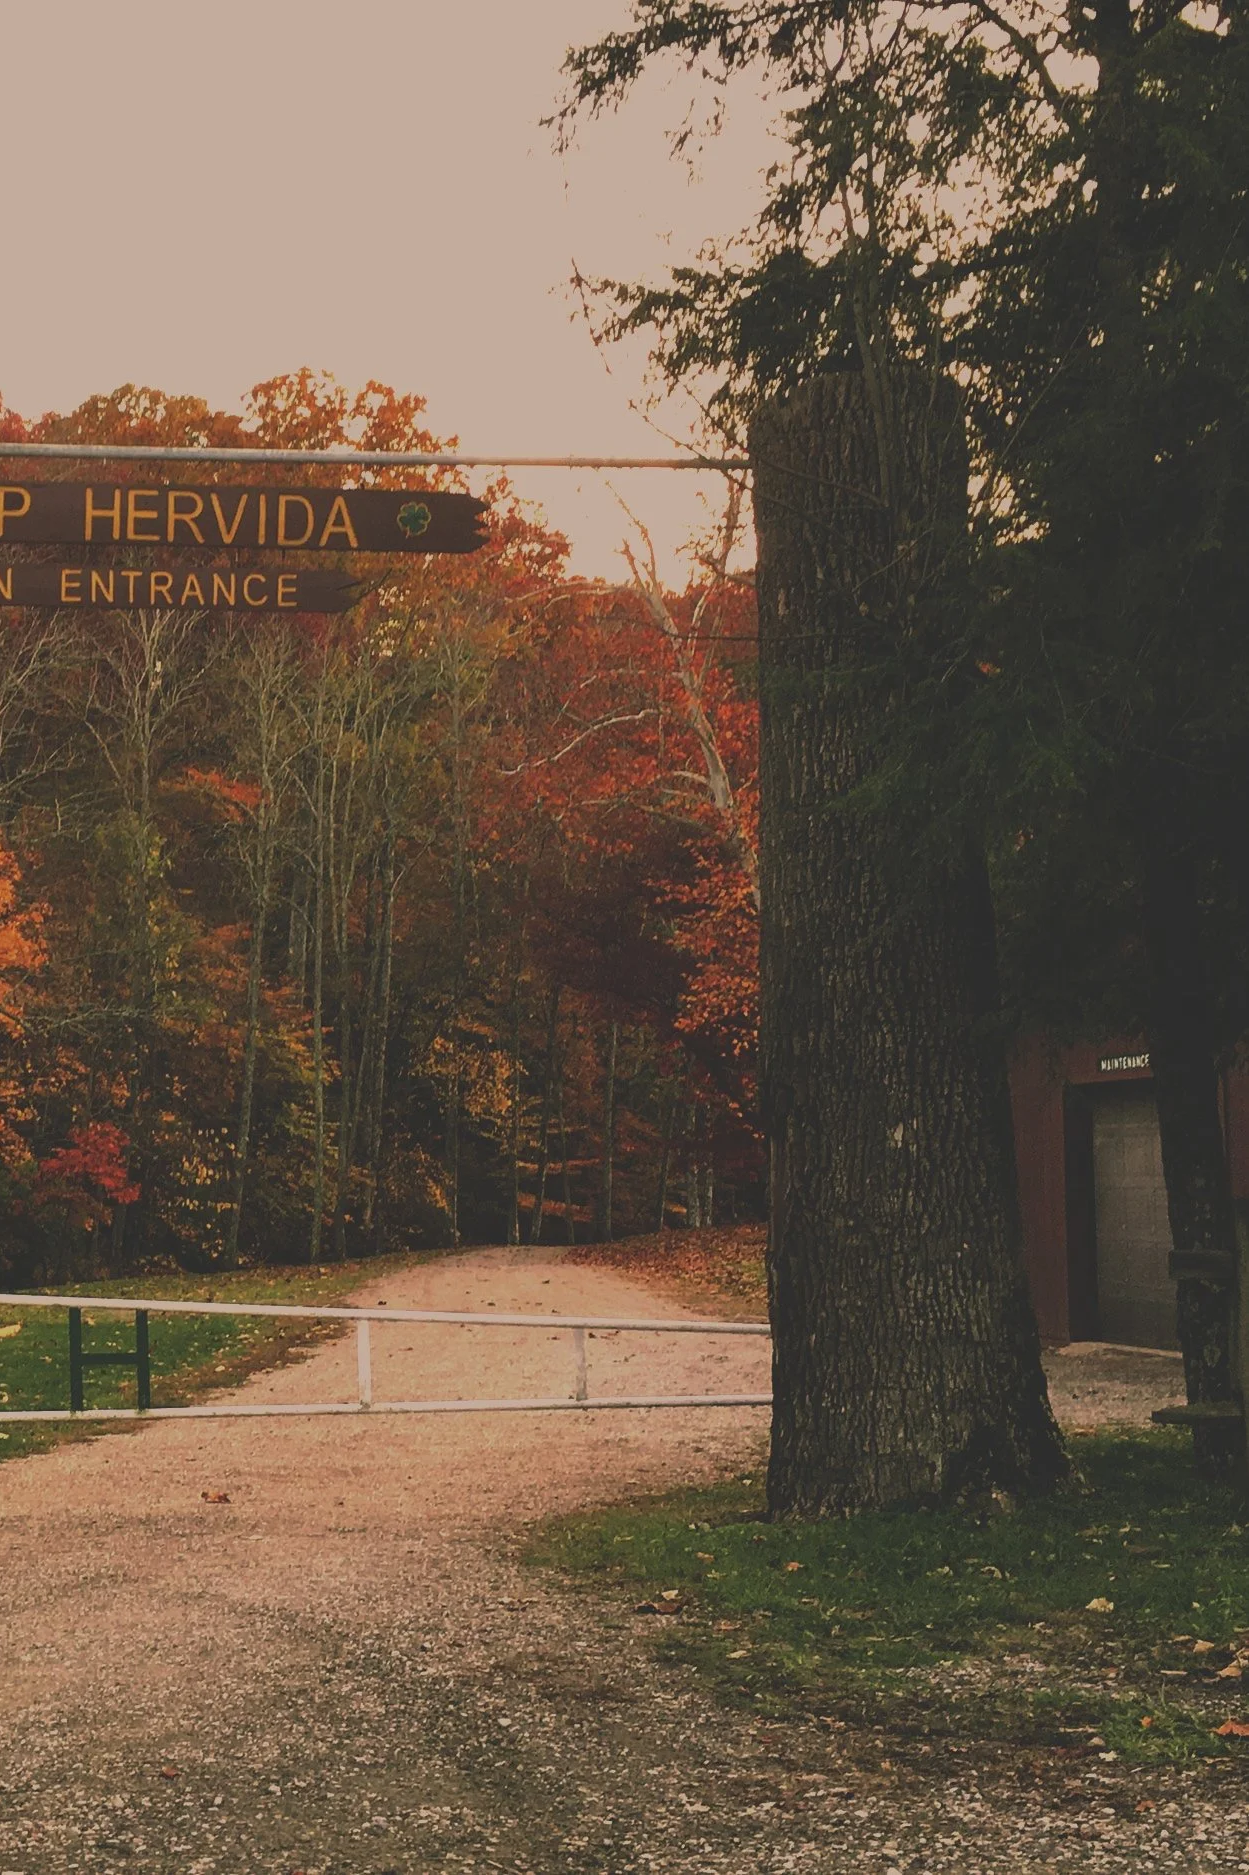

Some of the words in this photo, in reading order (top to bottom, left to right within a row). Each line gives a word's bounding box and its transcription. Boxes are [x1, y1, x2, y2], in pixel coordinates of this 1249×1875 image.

[84, 487, 359, 548] HERVIDA
[60, 569, 298, 607] ENTRANCE
[1101, 1053, 1150, 1071] MAINTENANCE
